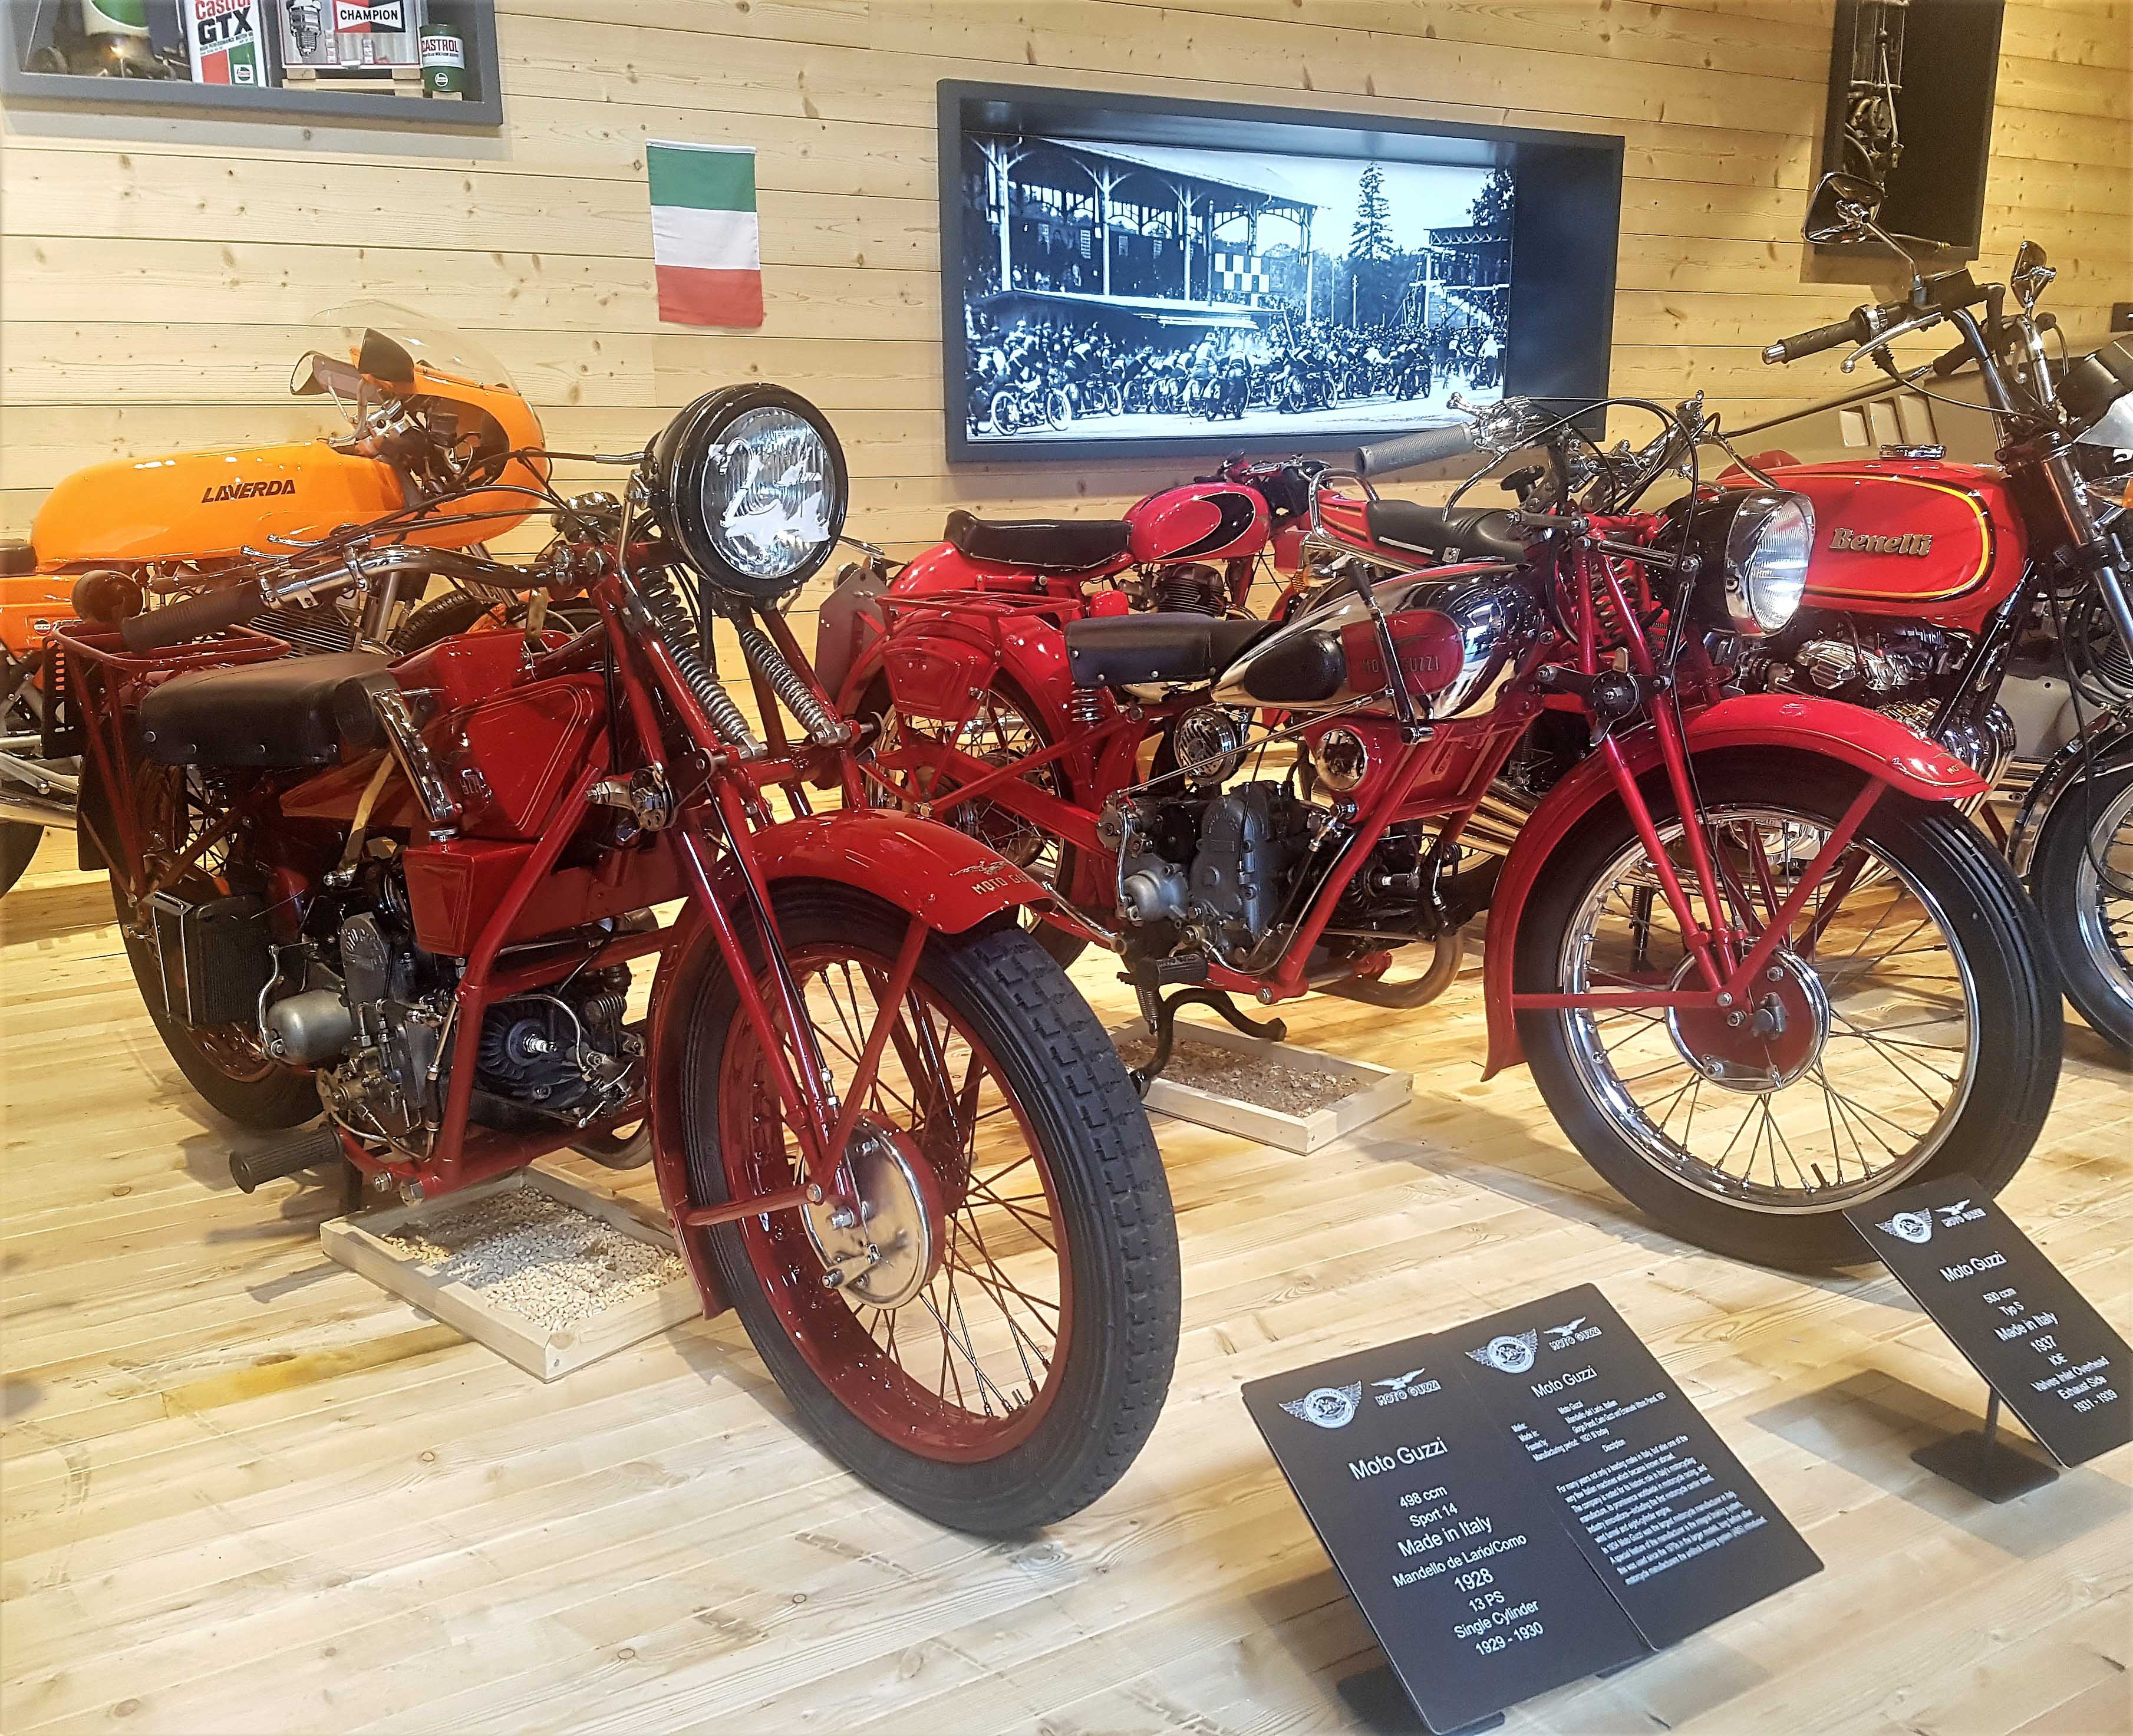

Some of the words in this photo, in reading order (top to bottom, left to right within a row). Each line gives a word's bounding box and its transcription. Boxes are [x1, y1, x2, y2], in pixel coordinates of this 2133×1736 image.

[195, 0, 250, 19] Cast
[341, 9, 398, 21] CHAMPION
[198, 6, 253, 45] GTX
[421, 39, 459, 52] CASTROL
[201, 479, 296, 503] LAVERDA
[1829, 528, 1933, 556] Benelli
[971, 877, 1008, 895] MOTO
[1939, 1264, 1974, 1282] Moto
[1970, 1250, 2007, 1271] Guzzi
[1998, 1305, 2017, 1316] Typ
[2013, 1301, 2024, 1310] S
[1993, 1323, 2027, 1340] Made
[2021, 1319, 2038, 1330] in
[2032, 1312, 2059, 1326] Italy
[1549, 1336, 1575, 1351] MOTO
[1575, 1326, 1602, 1341] GUZZI
[2030, 1335, 2056, 1353] 1937
[1374, 1389, 1407, 1406] MOTO
[1407, 1379, 1442, 1396] GUZZI
[1531, 1380, 1563, 1398] Moto
[1562, 1365, 1598, 1386] Guzzi
[2073, 1398, 2095, 1412] 1931
[2096, 1389, 2118, 1403] 1939
[1348, 1456, 1396, 1480] Moto
[1397, 1437, 1448, 1465] Guzzi
[1399, 1493, 1422, 1507] 498
[1423, 1485, 1448, 1501] ccm
[1409, 1508, 1443, 1527] Sport
[1442, 1503, 1458, 1517] 14
[1397, 1533, 1443, 1557] Made
[1442, 1527, 1461, 1543] in
[1458, 1516, 1492, 1537] Italy
[1392, 1560, 1447, 1587] Mandello
[1447, 1556, 1463, 1569] de
[1462, 1534, 1527, 1564] Lario/Como
[1454, 1568, 1494, 1592] 1928
[1469, 1597, 1485, 1612] 13
[1484, 1590, 1505, 1607] PS
[1454, 1619, 1492, 1639] Single
[1491, 1600, 1539, 1625] Cylinder
[1475, 1635, 1506, 1655] 1929
[1513, 1622, 1543, 1642] 1930
